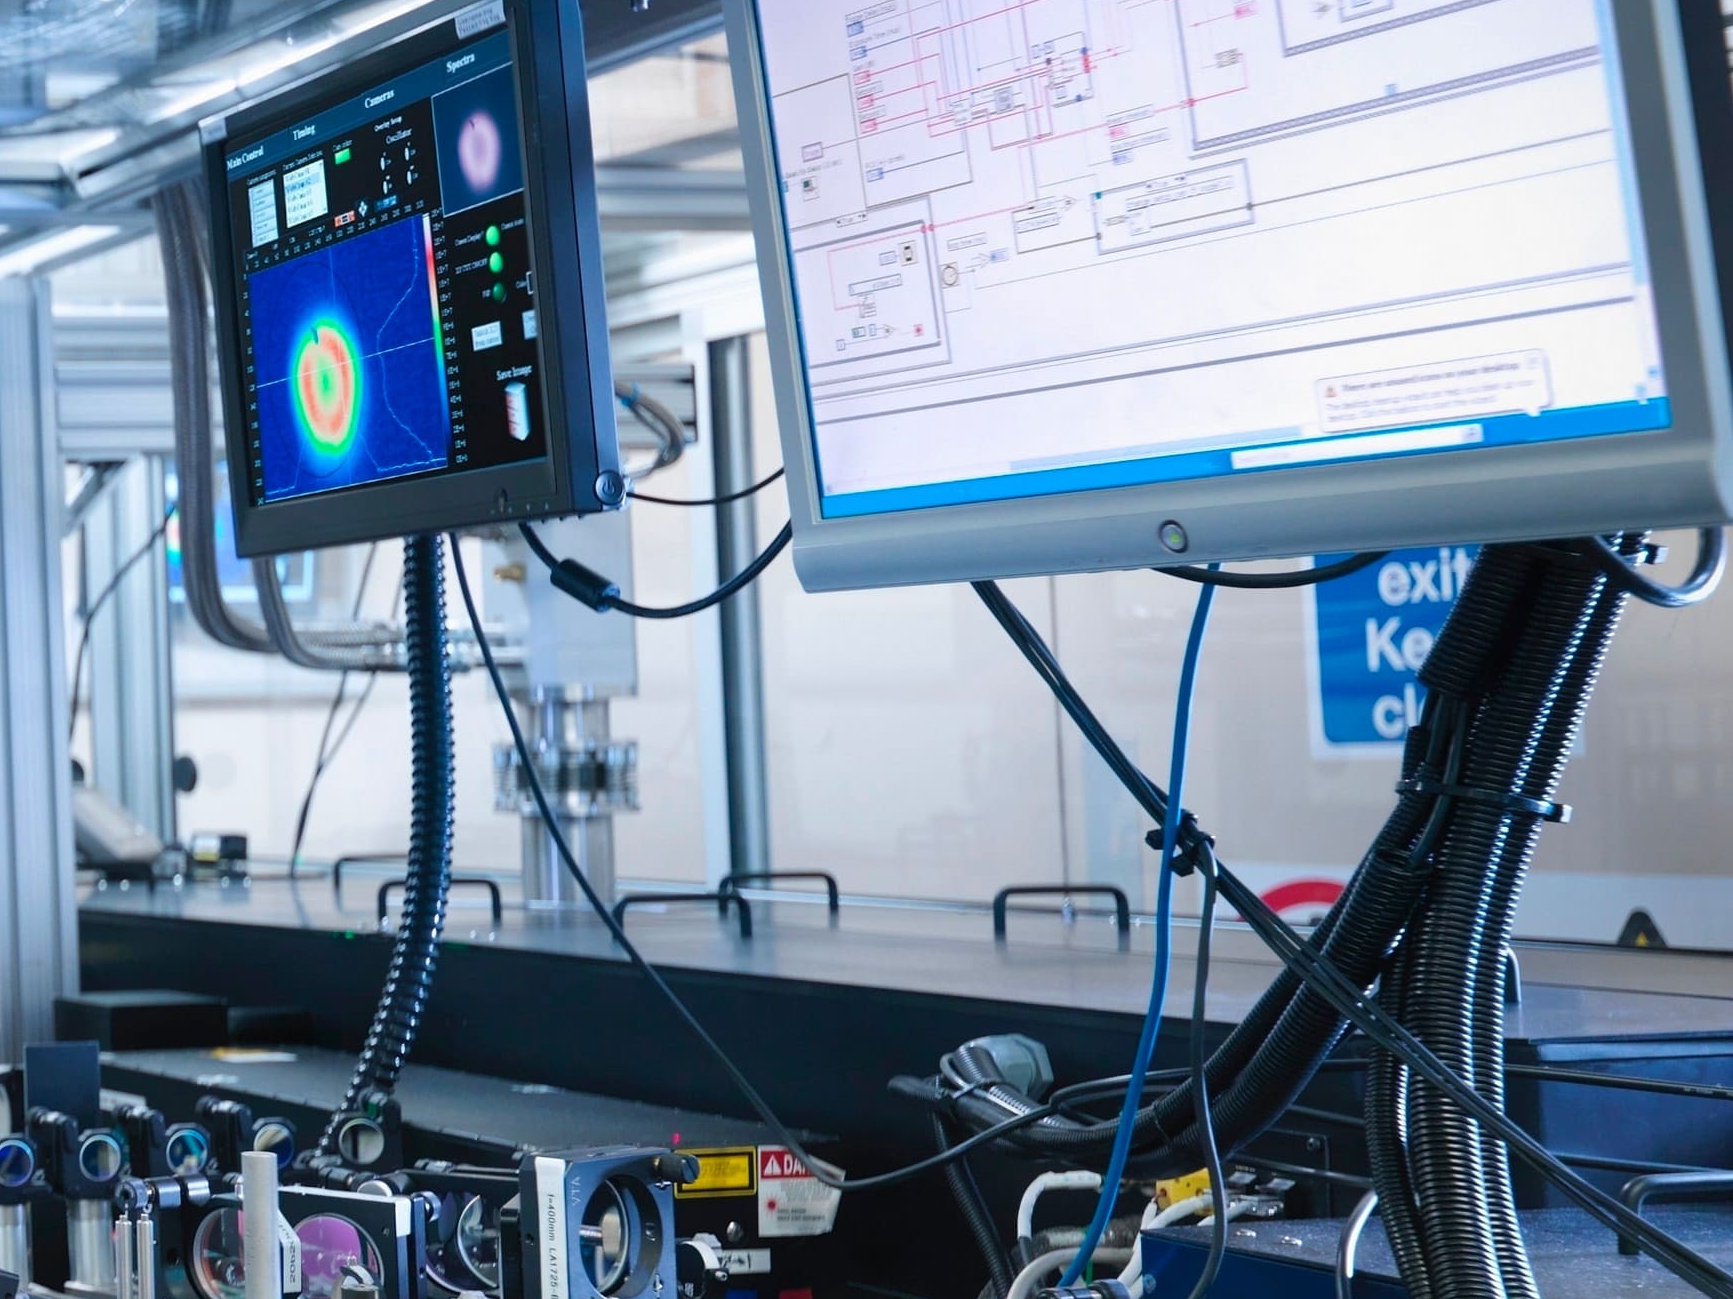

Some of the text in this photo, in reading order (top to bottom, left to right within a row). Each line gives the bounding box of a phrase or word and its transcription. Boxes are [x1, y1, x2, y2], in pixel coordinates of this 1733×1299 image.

[446, 53, 475, 74] Spectra
[364, 89, 395, 109] Cameras
[226, 157, 242, 171] Main
[241, 145, 265, 164] Control
[1366, 616, 1433, 672] Ke
